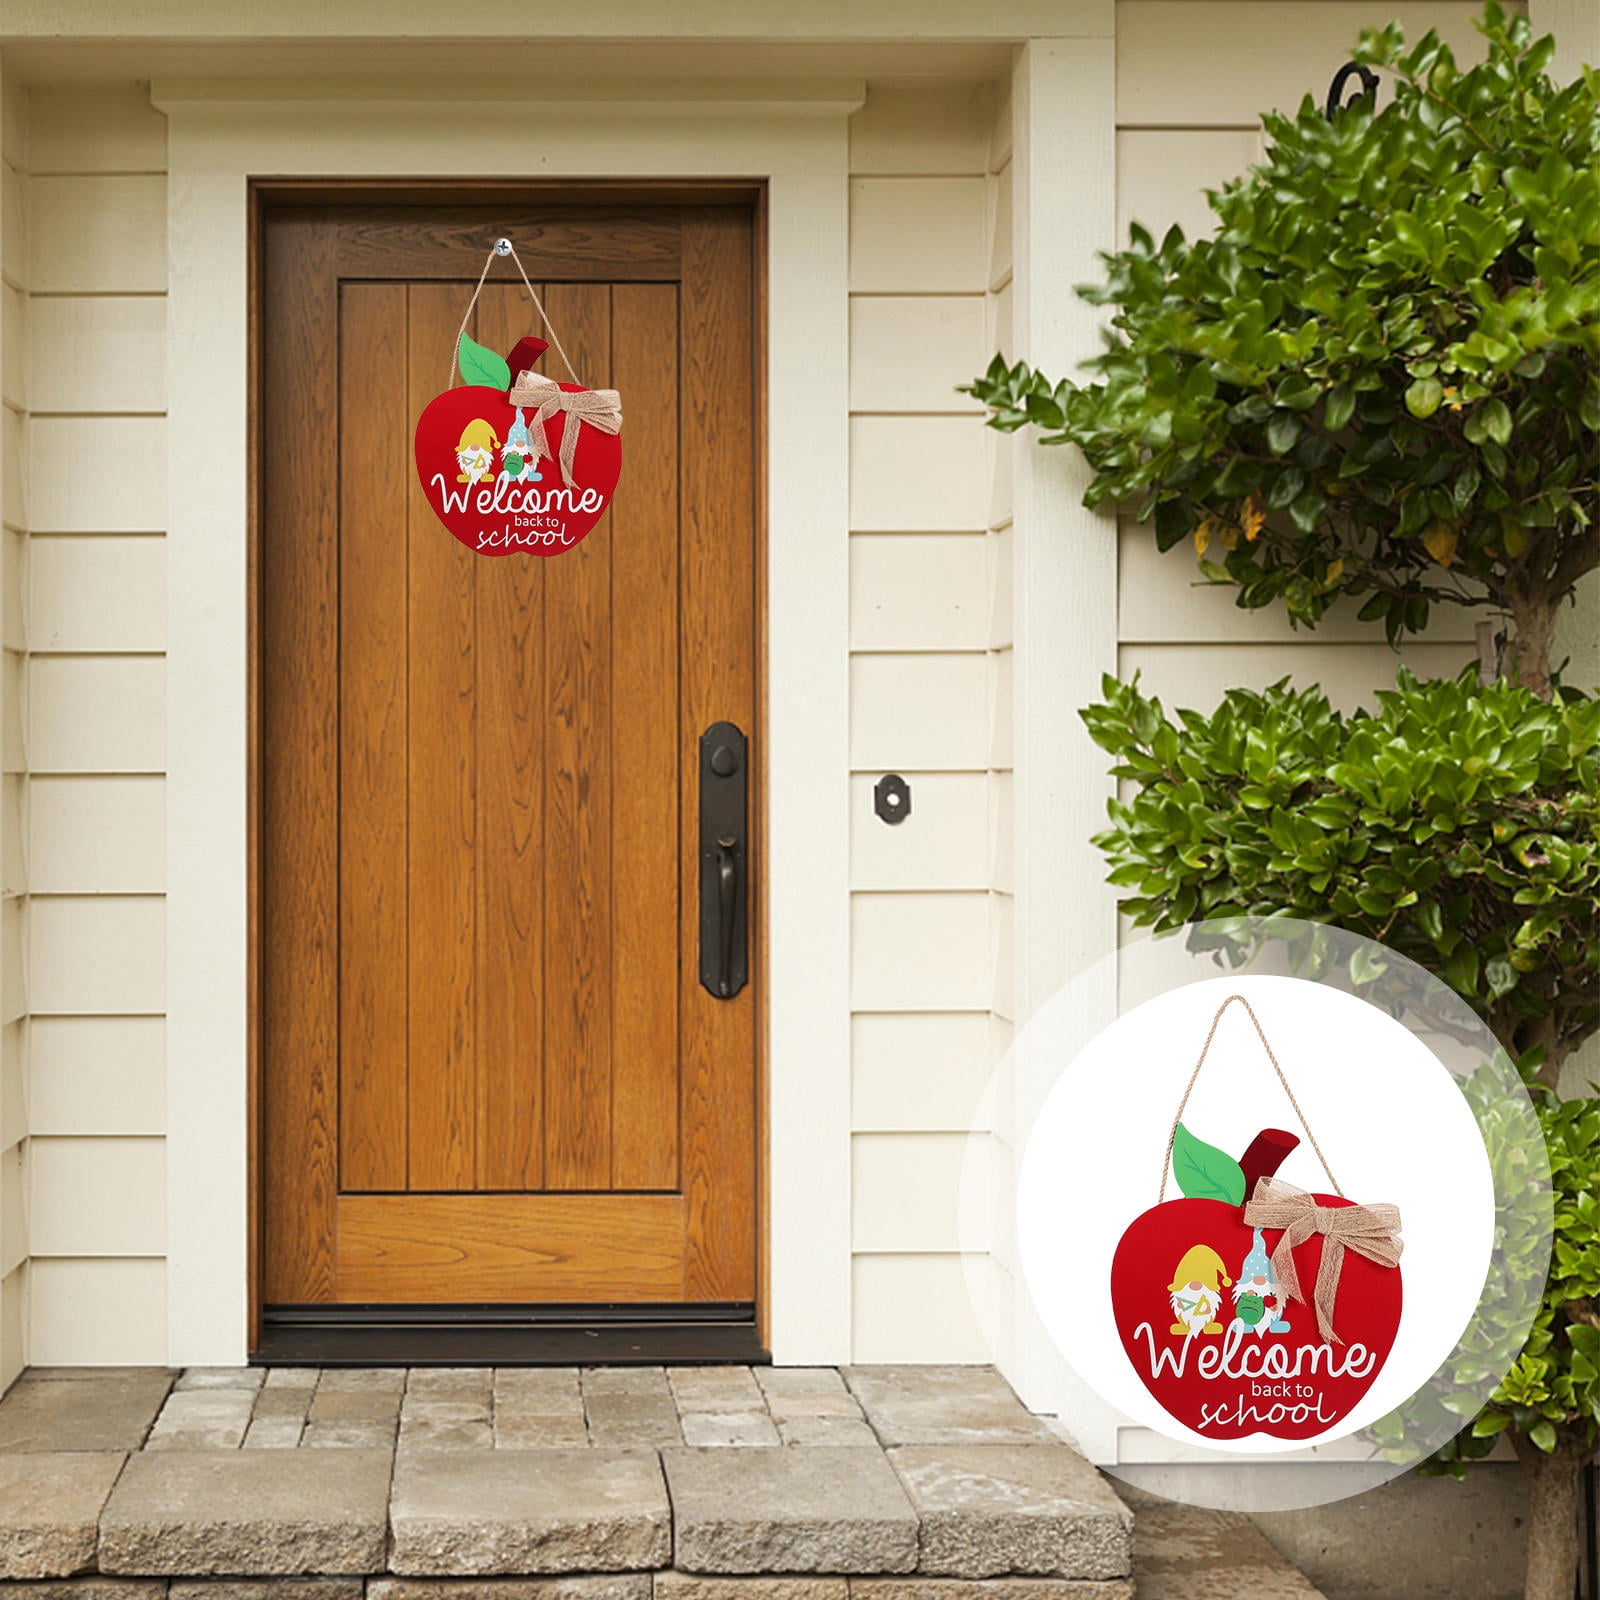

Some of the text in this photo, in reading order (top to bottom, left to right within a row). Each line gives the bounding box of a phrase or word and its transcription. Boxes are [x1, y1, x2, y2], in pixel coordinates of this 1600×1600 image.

[431, 470, 604, 514] Welcome
[476, 523, 575, 549] school
[514, 515, 559, 527] back to
[1133, 1317, 1376, 1379] Welcome
[1251, 1381, 1314, 1398] back to
[1197, 1392, 1336, 1429] school
